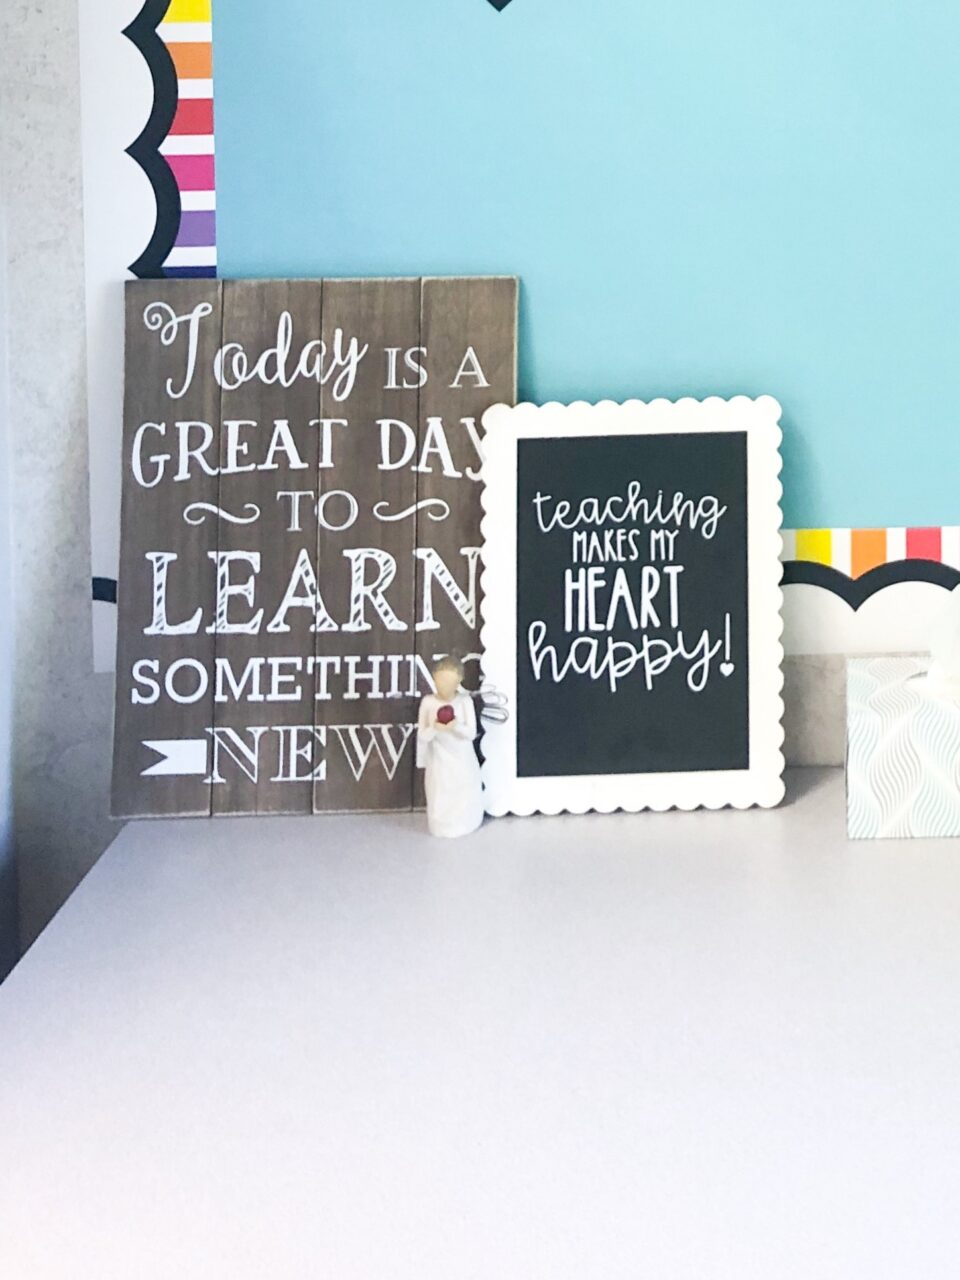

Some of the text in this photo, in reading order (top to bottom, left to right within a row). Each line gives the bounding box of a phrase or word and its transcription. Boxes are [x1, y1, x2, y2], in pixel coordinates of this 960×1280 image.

[144, 301, 491, 402] Today IS A
[131, 419, 348, 487] GREAT
[276, 490, 359, 532] TO
[532, 480, 727, 539] teaching
[572, 528, 679, 563] MAKES MY
[143, 547, 483, 635] LEARN
[564, 565, 685, 632] HEART
[131, 652, 482, 704] SOMETHIN
[528, 612, 735, 692] happy!
[203, 722, 419, 784] NEW
